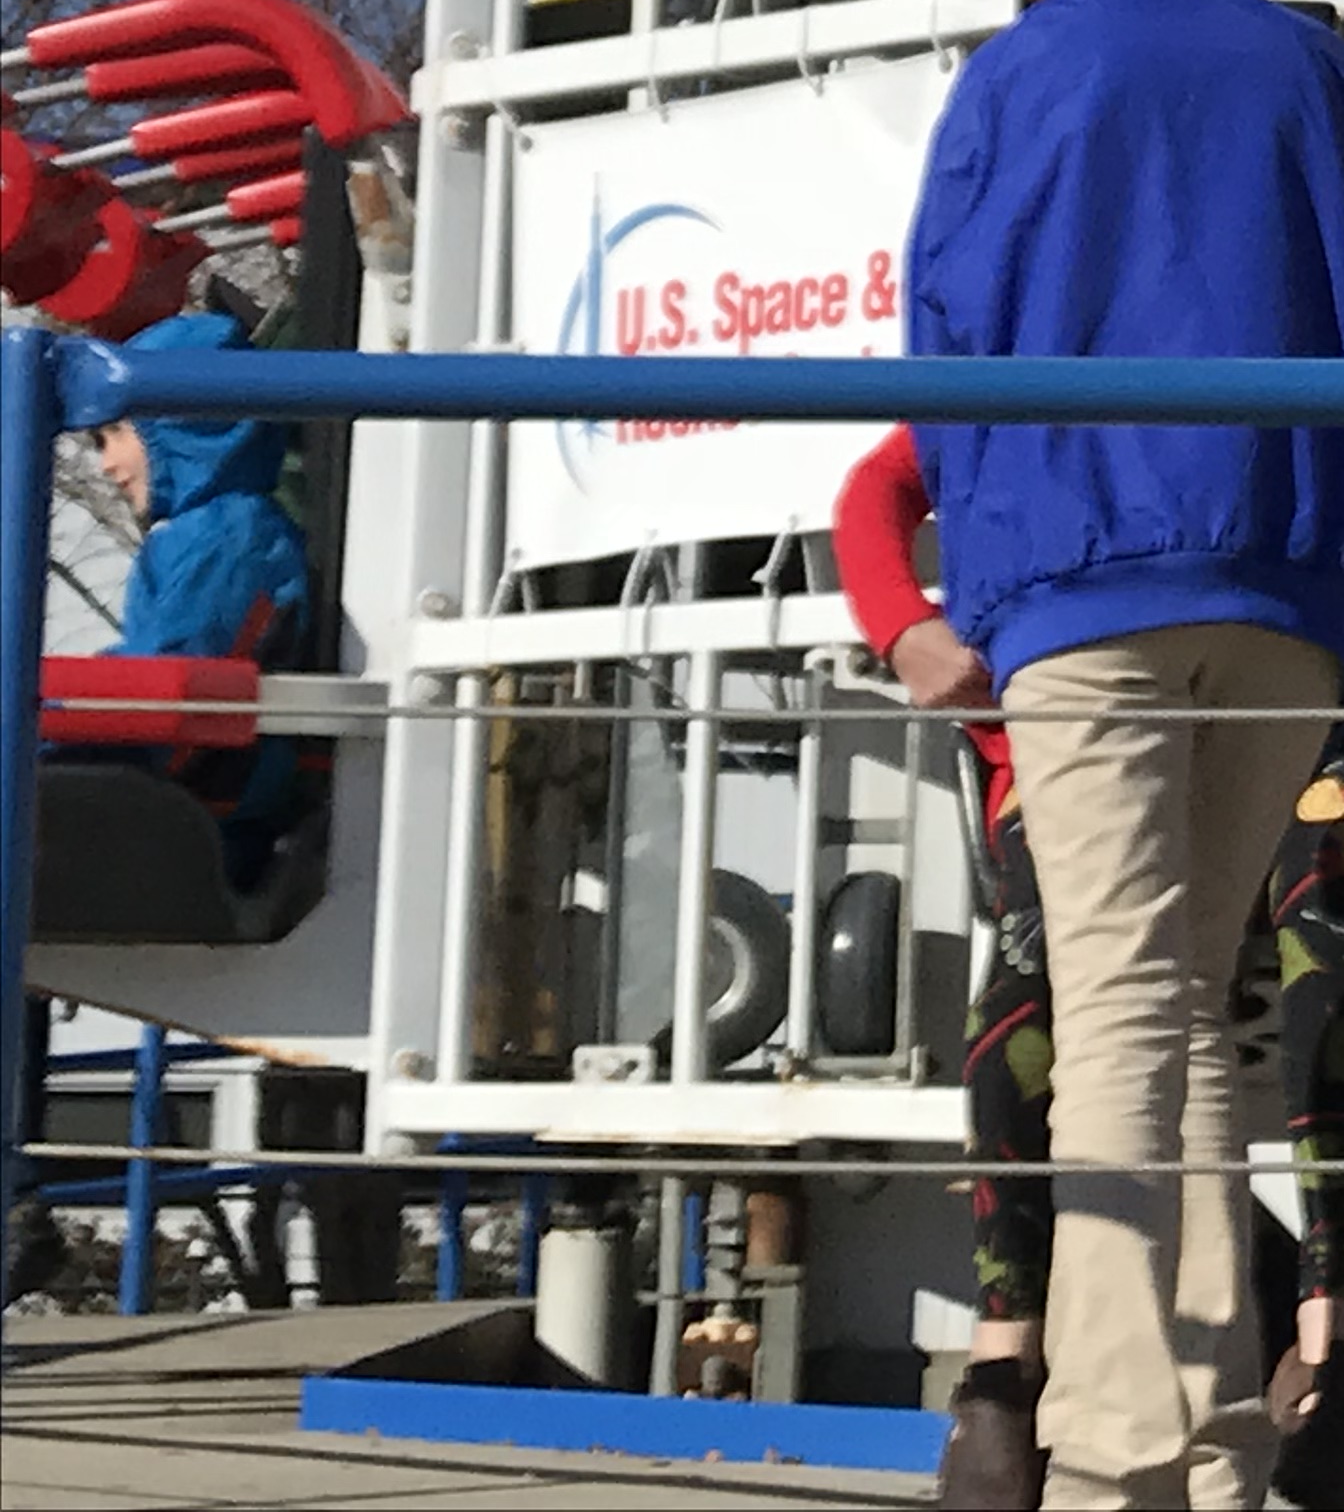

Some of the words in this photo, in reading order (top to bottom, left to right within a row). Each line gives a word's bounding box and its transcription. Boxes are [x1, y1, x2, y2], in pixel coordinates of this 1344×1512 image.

[616, 279, 700, 357] U.S.
[712, 271, 849, 355] Space
[861, 249, 897, 322] &
